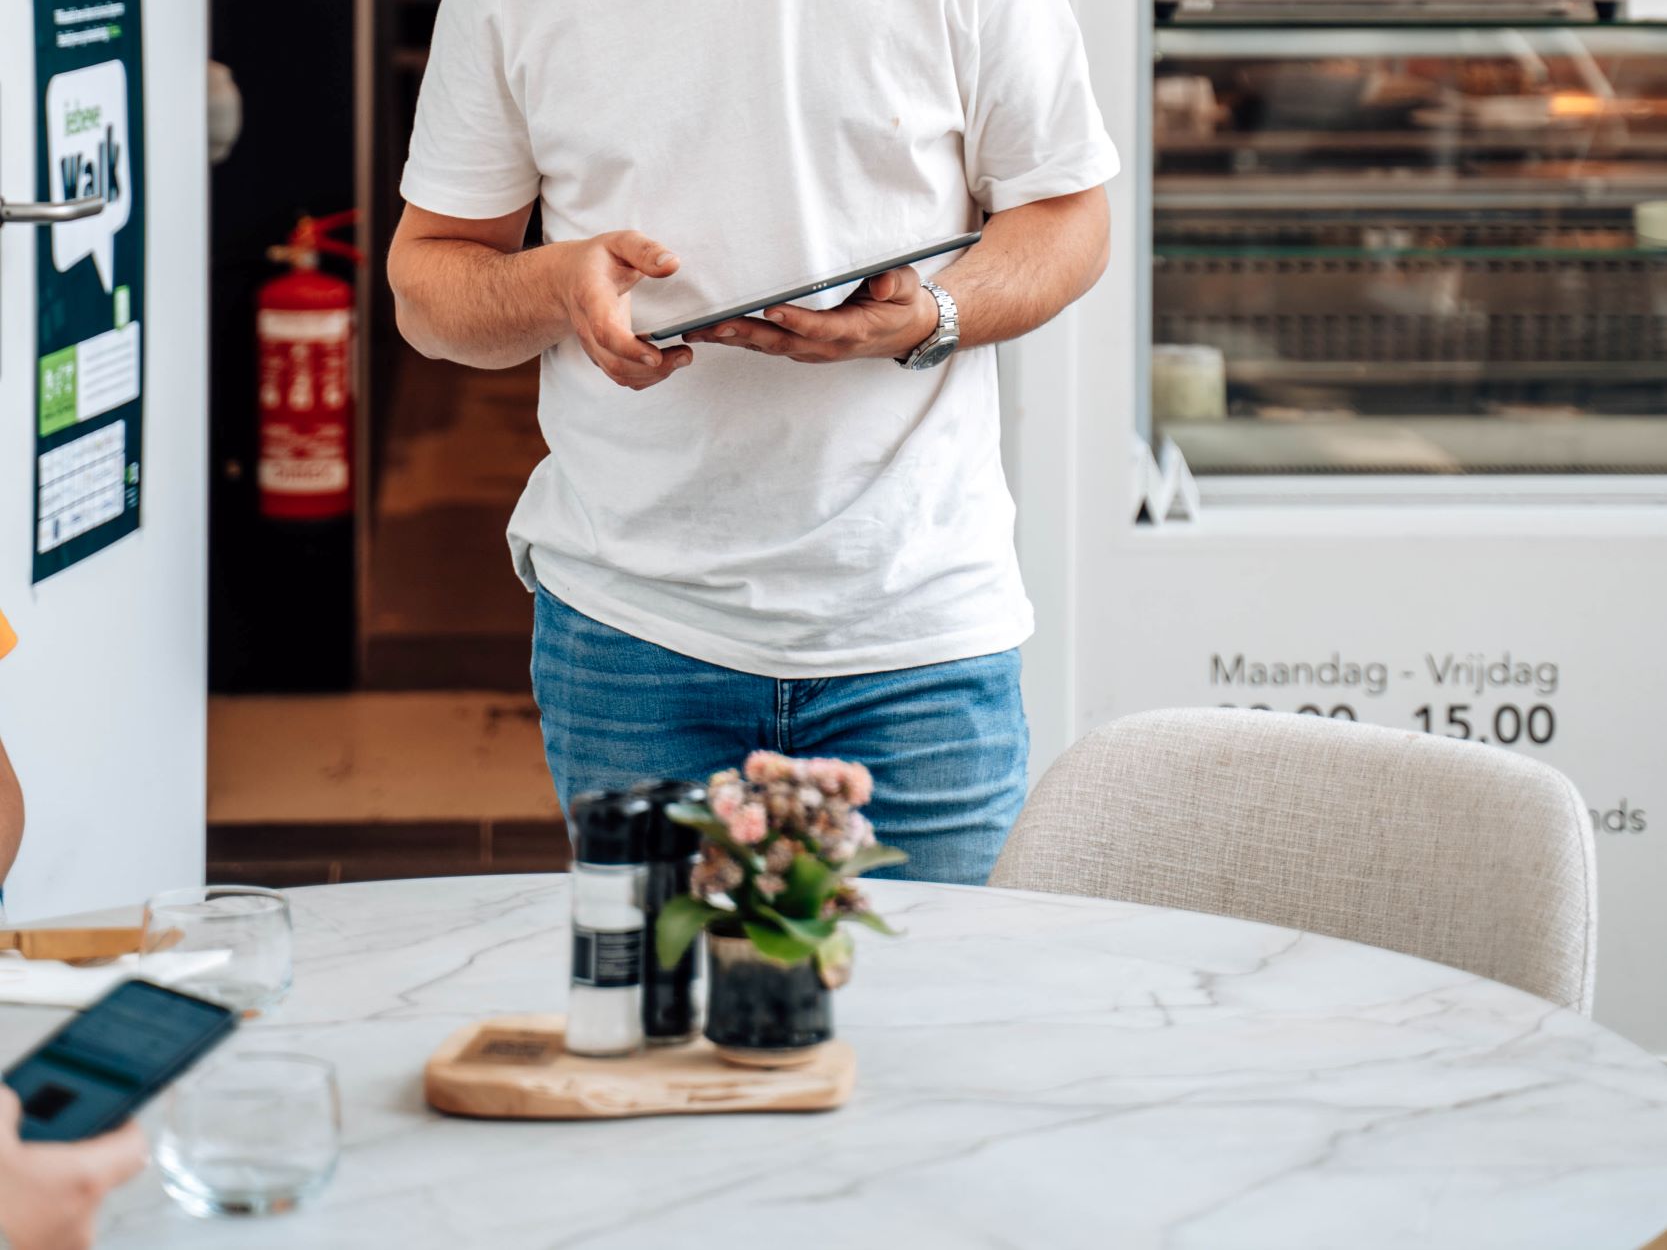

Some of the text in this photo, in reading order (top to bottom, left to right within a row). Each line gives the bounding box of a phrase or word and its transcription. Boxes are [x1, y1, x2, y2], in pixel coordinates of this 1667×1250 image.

[1211, 651, 1387, 696] Maandag
[1425, 651, 1558, 695] Vrijdag
[1414, 704, 1556, 744] 15.00
